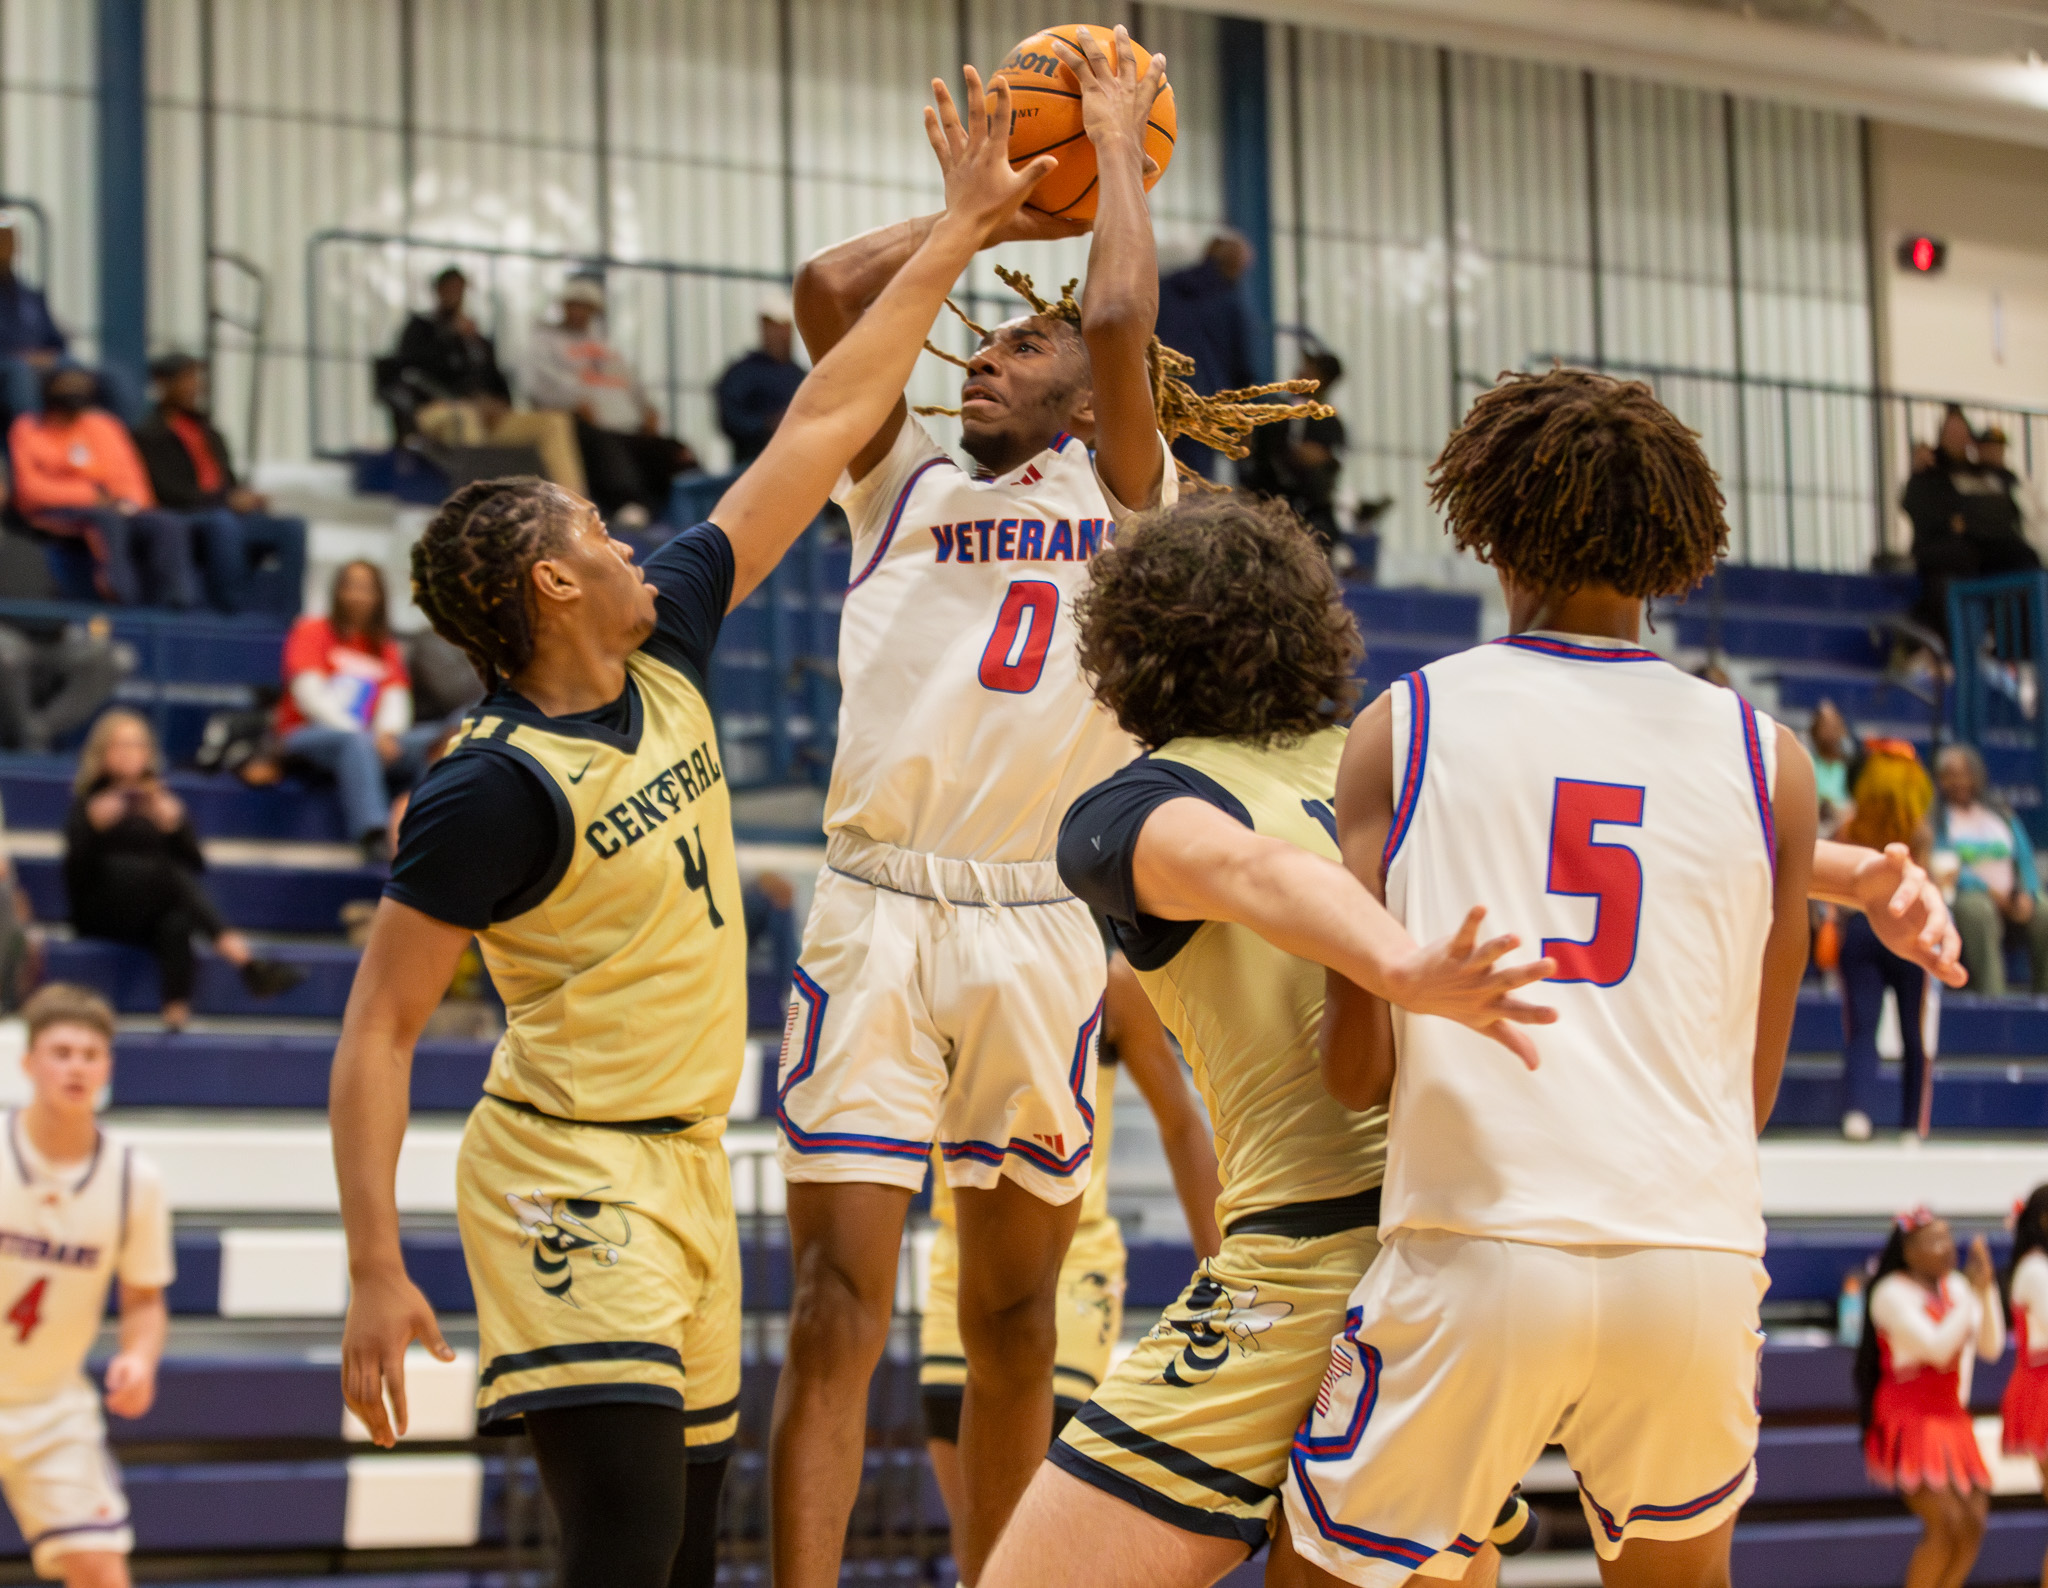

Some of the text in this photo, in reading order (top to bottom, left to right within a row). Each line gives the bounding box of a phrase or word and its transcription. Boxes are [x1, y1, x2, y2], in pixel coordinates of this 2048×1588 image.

[930, 518, 1116, 563] VETERAN
[978, 580, 1059, 694] 0
[584, 741, 721, 860] CENTRAL
[674, 824, 725, 930] 4
[1541, 777, 1646, 988] 5
[6, 1276, 48, 1344] 4
